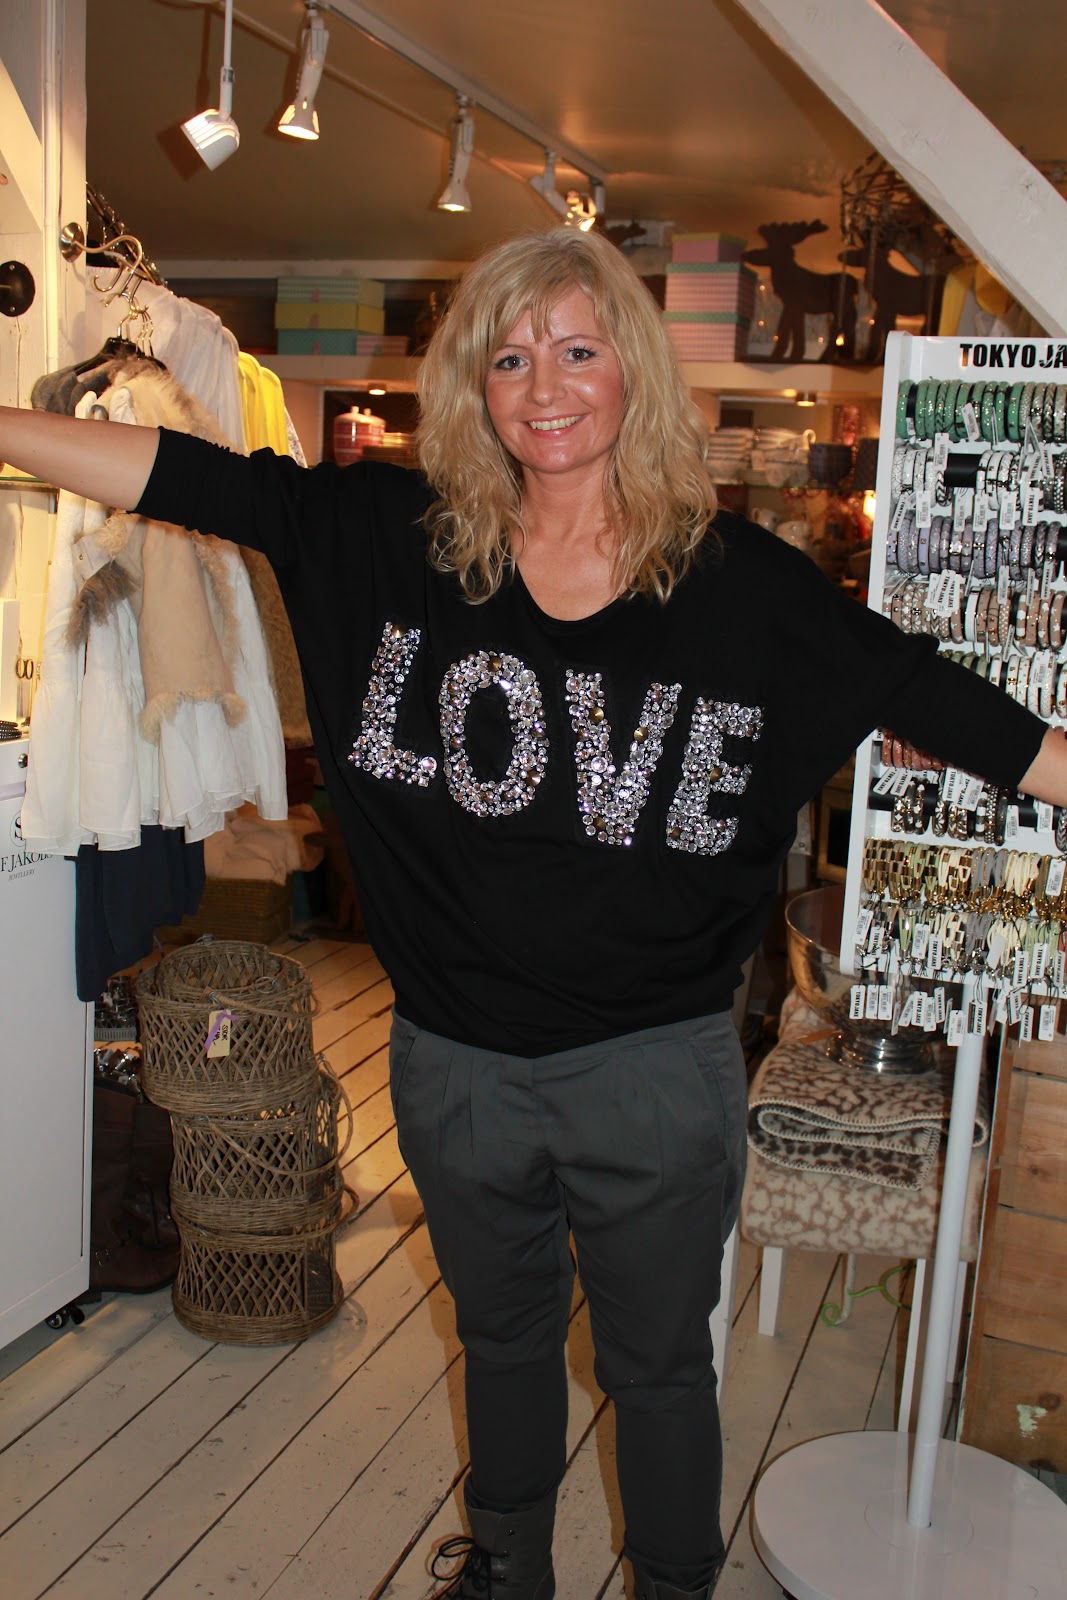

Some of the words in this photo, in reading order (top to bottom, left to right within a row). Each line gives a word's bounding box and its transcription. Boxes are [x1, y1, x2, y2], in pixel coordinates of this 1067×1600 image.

[960, 344, 1036, 368] TOKYO
[348, 621, 764, 856] LOVE
[8, 852, 53, 872] JAKO
